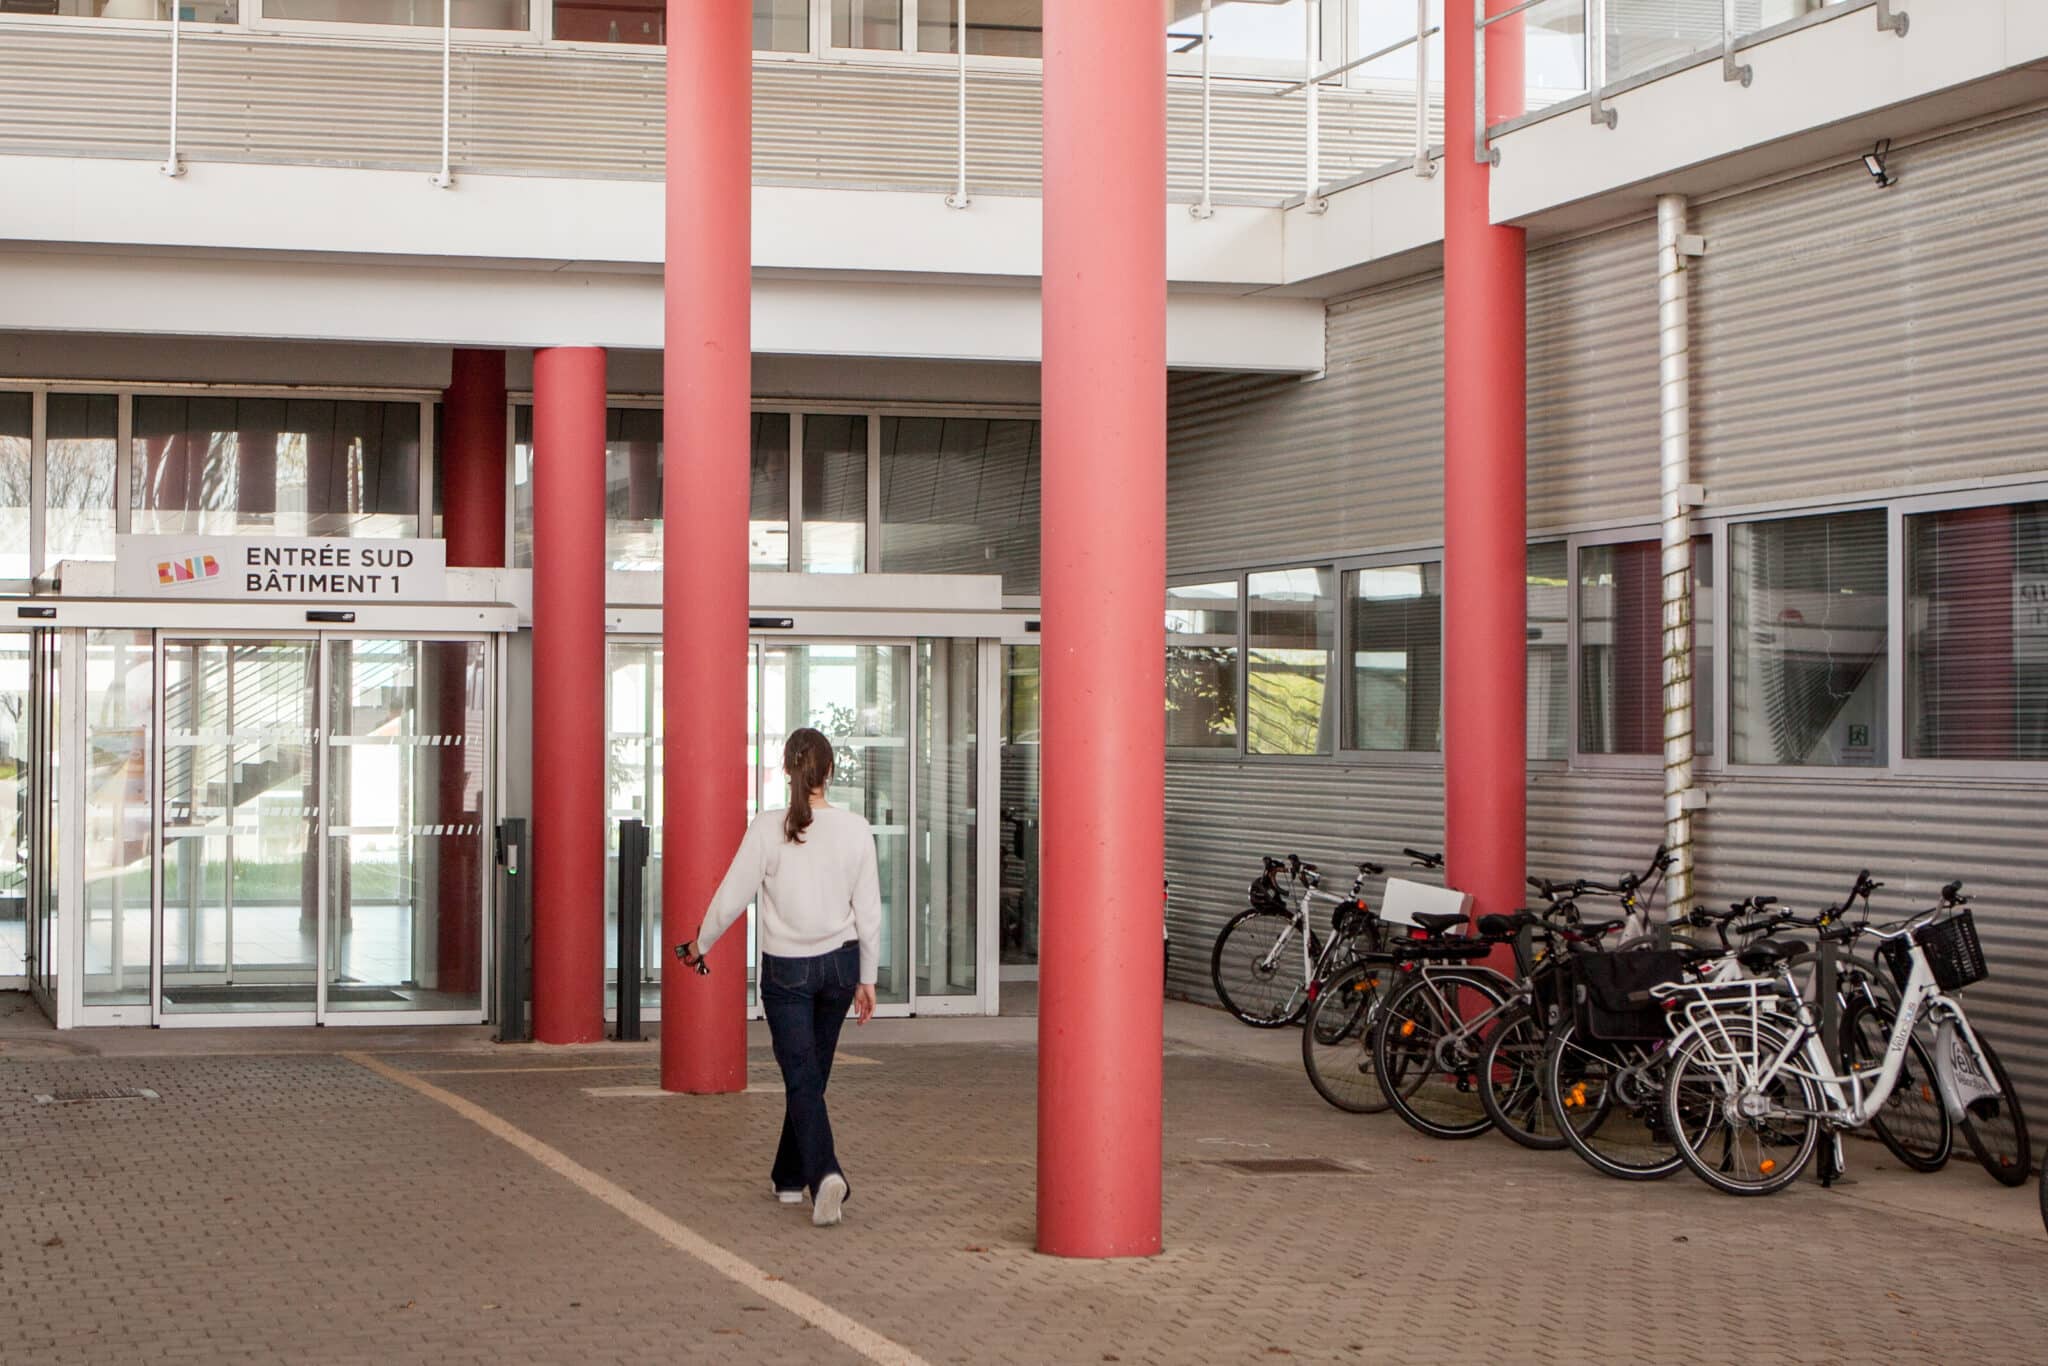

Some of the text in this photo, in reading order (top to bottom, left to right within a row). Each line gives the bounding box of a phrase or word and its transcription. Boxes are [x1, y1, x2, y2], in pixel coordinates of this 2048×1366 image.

[246, 544, 413, 567] ENTRÉE SUD
[157, 555, 220, 584] ENIB
[246, 569, 400, 593] BÂTIMENT 1
